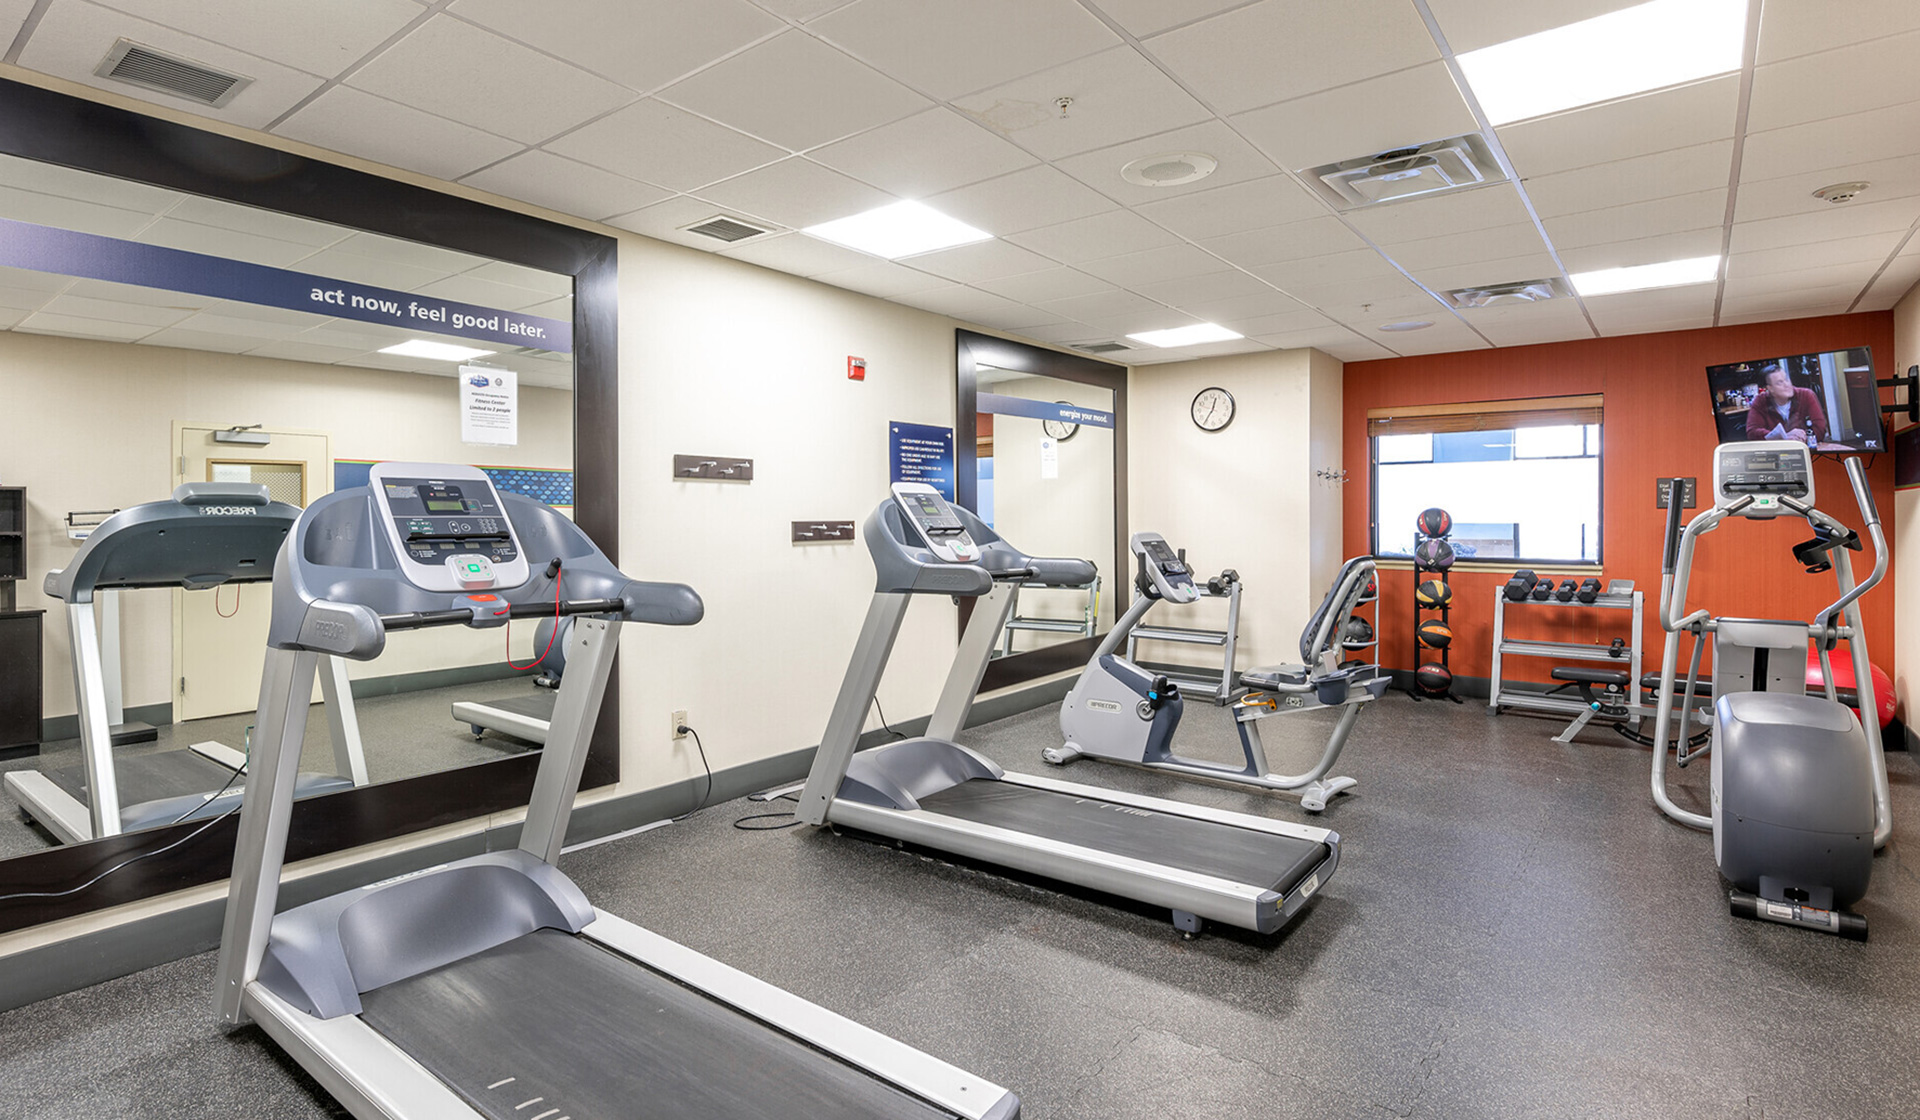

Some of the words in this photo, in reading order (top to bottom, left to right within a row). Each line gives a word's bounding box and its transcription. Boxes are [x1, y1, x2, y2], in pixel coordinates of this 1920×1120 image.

[310, 287, 345, 305] act
[351, 293, 402, 317] now,
[408, 302, 446, 322] feel
[452, 312, 499, 331] good
[504, 318, 547, 339] later.
[1059, 409, 1080, 420] energize
[1081, 412, 1092, 421] your
[1864, 439, 1877, 448] FX
